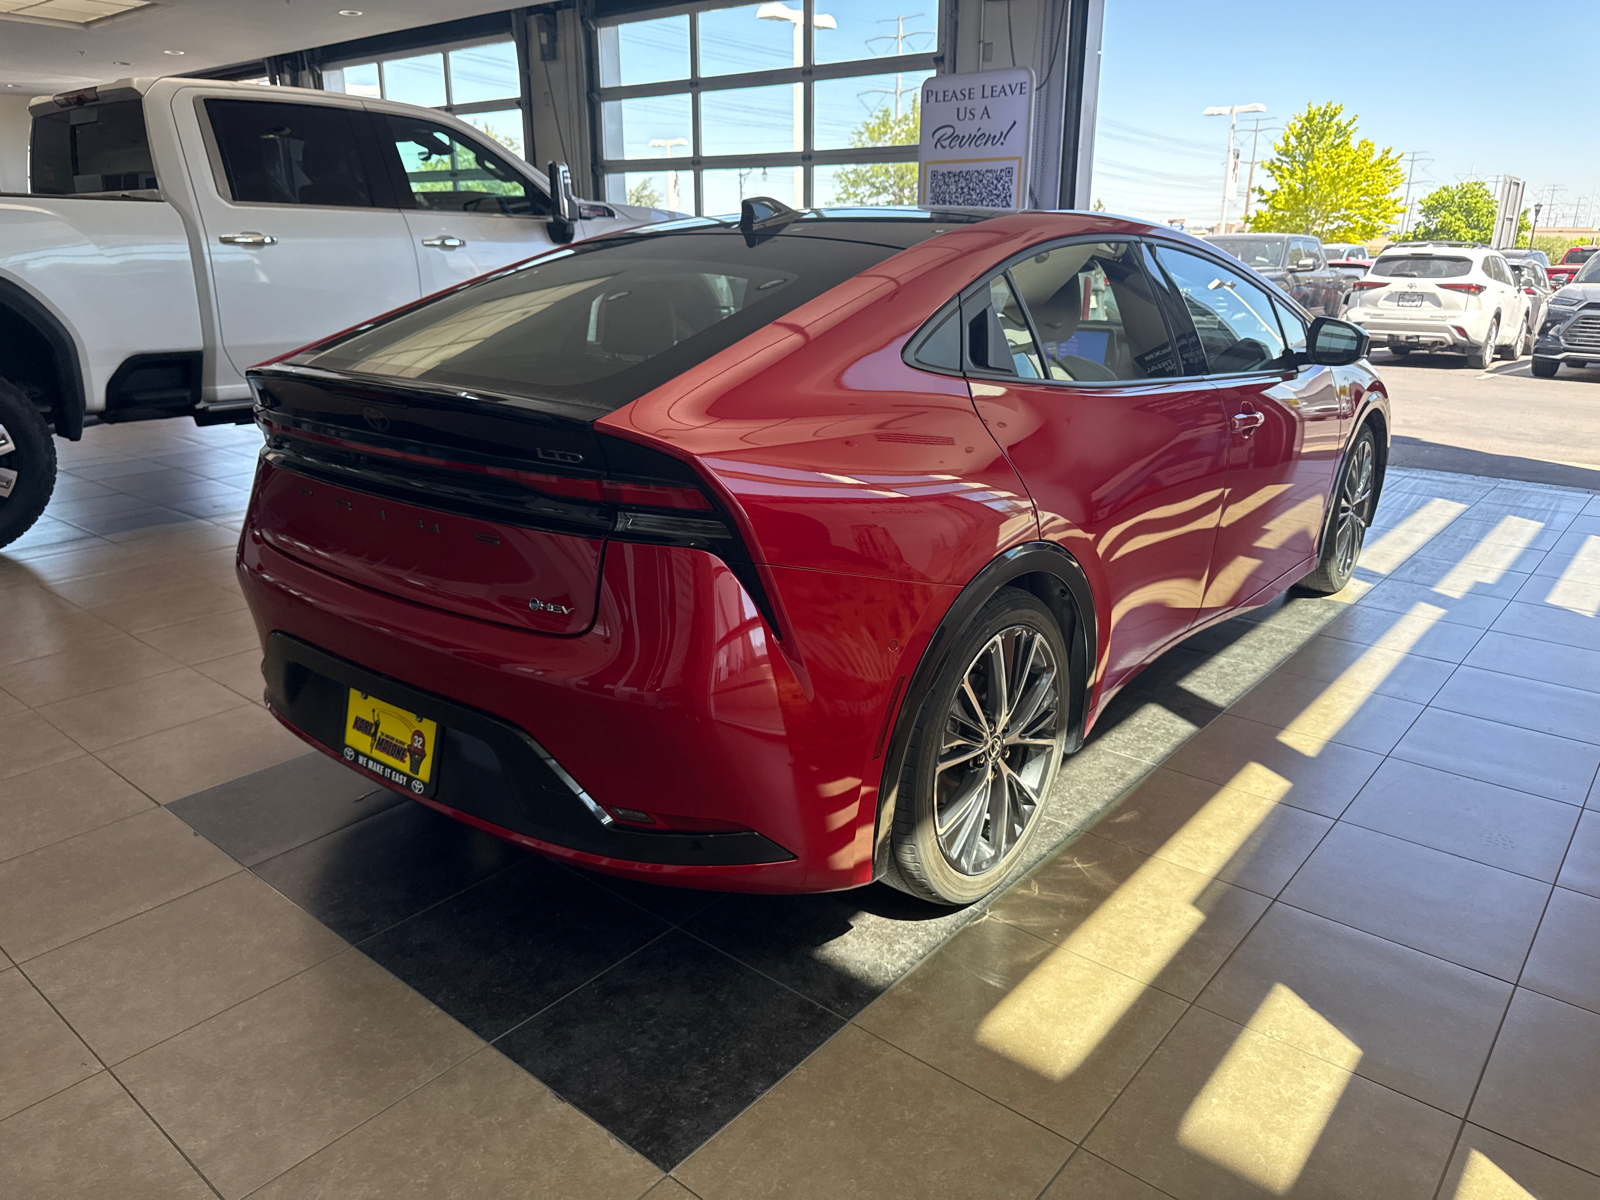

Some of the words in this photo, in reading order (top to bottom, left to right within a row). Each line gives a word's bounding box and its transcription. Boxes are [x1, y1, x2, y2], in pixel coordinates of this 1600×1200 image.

[925, 87, 976, 104] PLEASE
[981, 82, 1027, 99] LEAVE
[956, 106, 976, 122] US
[980, 105, 991, 120] A
[931, 120, 1017, 150] Review!
[535, 446, 584, 464] LTD
[352, 715, 375, 738] KARL
[375, 736, 408, 763] MALONE
[413, 735, 424, 749] 32
[358, 754, 368, 767] WE
[367, 759, 384, 775] MAKE
[384, 767, 392, 778] IT
[391, 770, 408, 786] EASY
